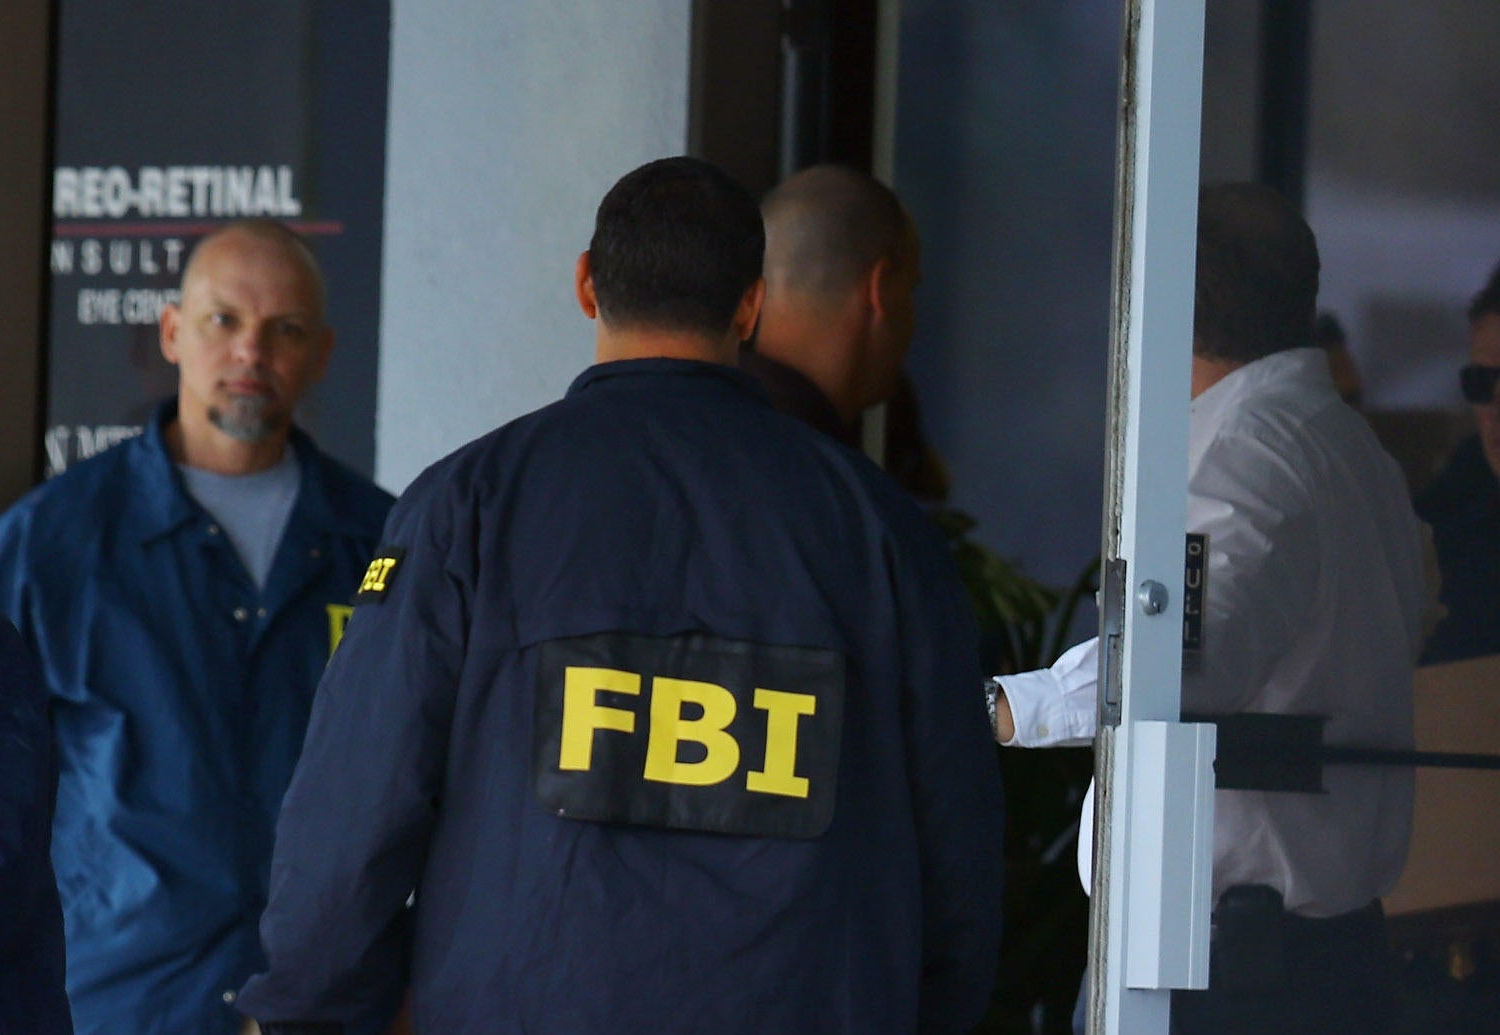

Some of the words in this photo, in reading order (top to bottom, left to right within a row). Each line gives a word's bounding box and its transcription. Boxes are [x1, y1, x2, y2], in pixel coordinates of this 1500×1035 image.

[52, 165, 302, 218] REO-RETINAL
[77, 288, 122, 325] EYE
[358, 558, 396, 594] BI
[559, 666, 817, 798] FBI
